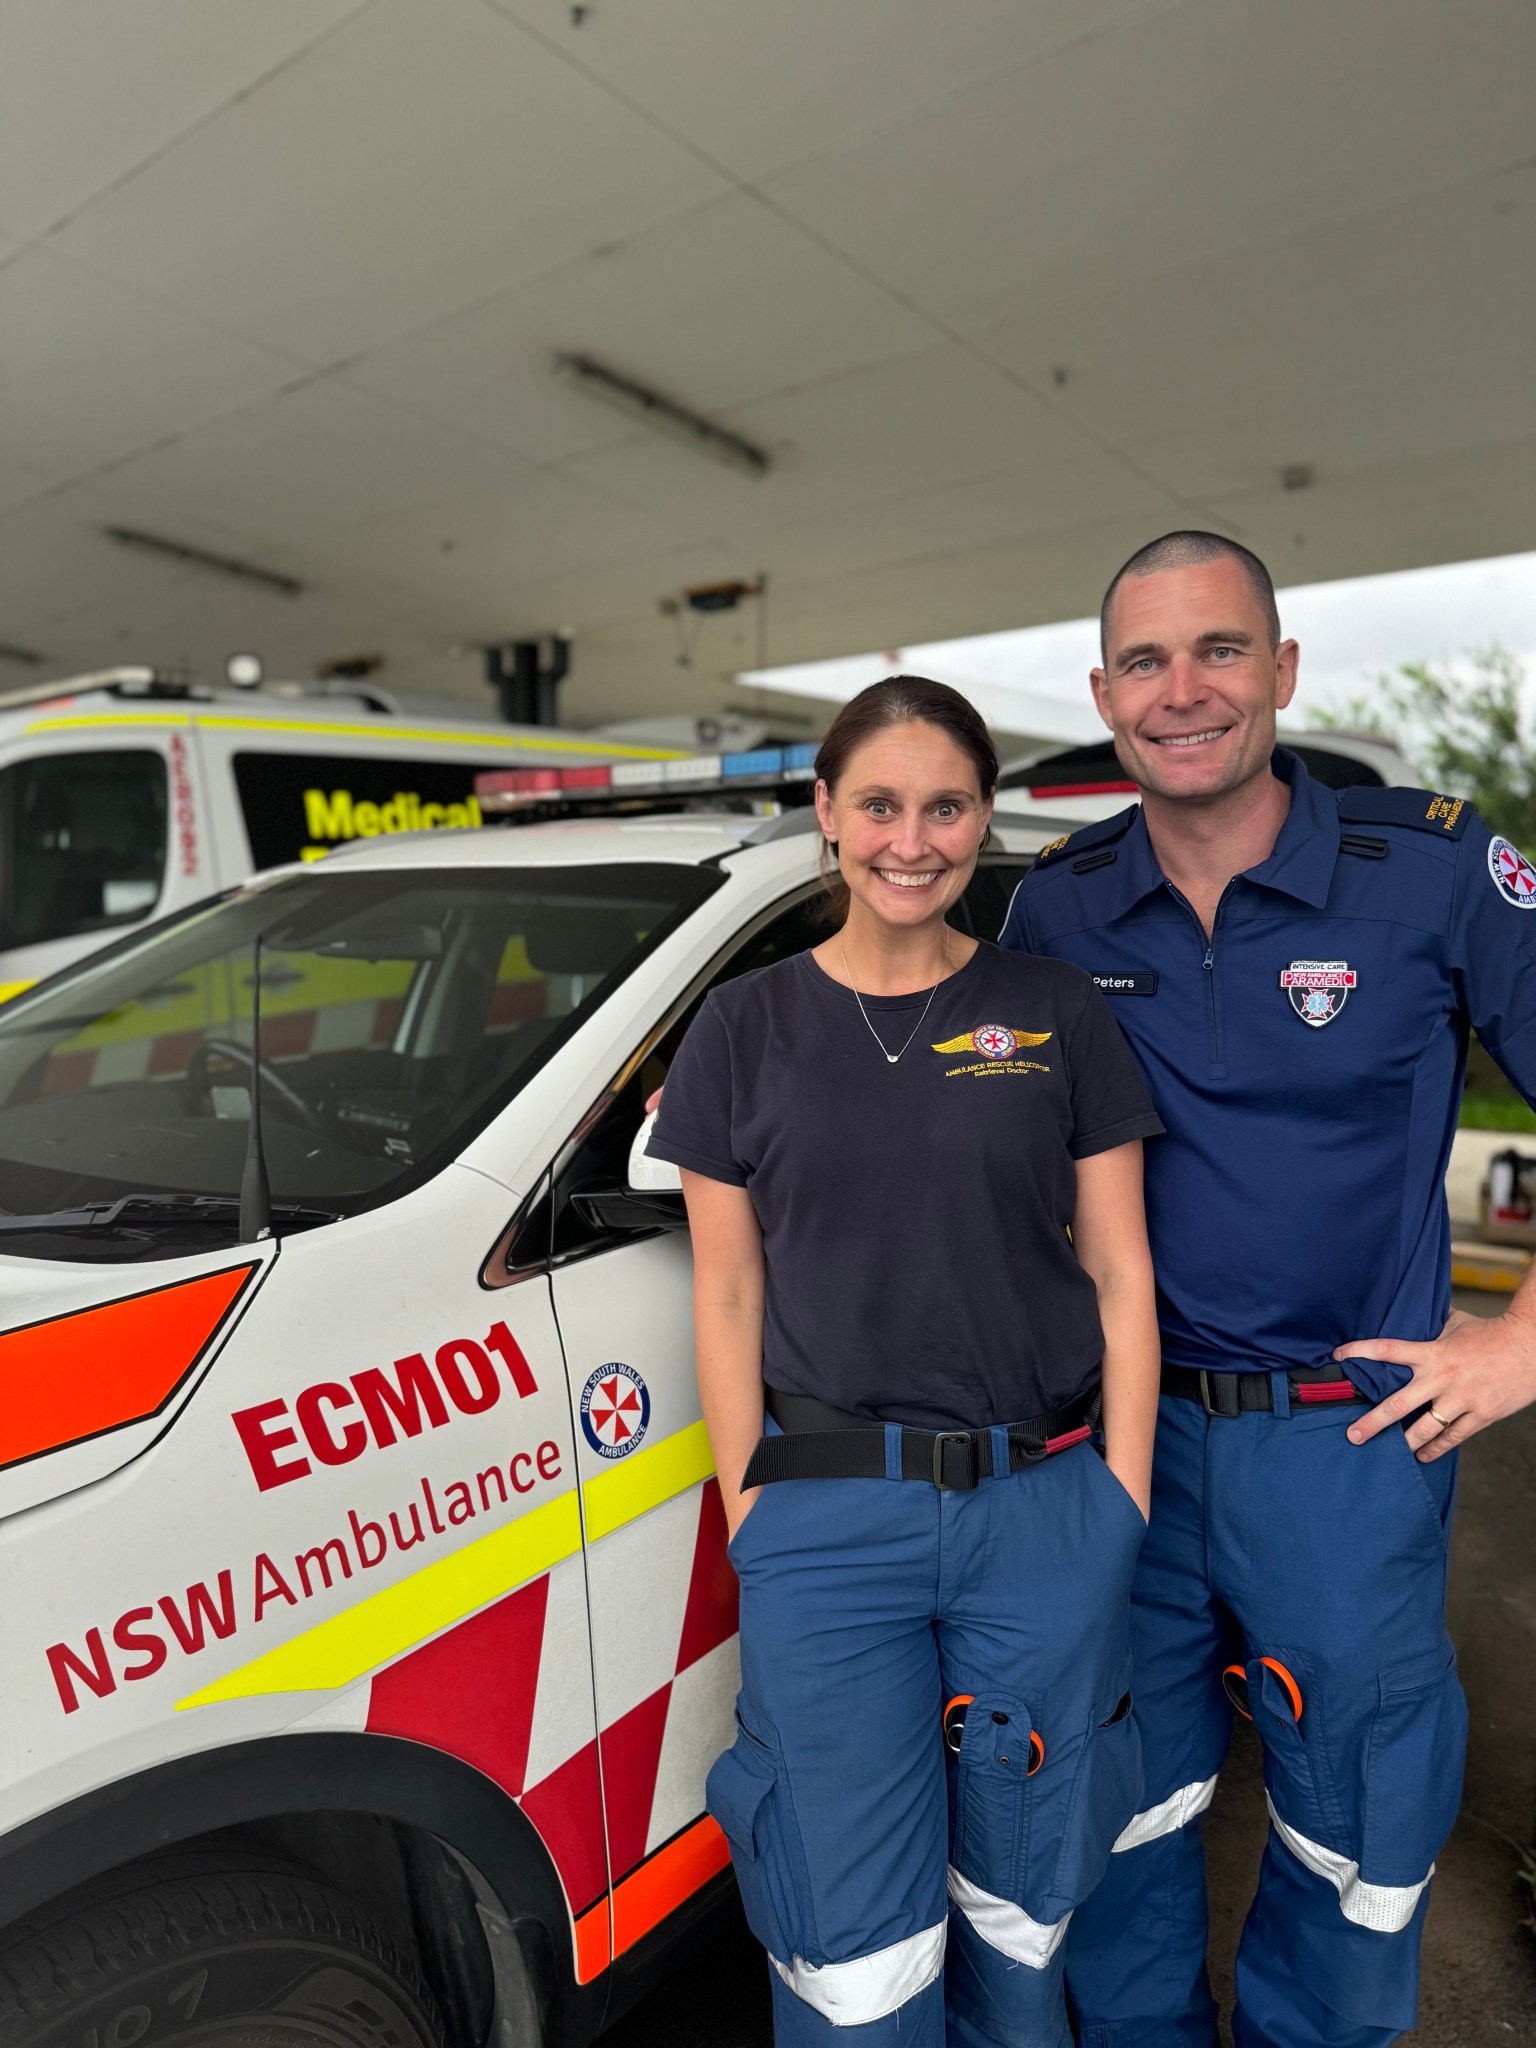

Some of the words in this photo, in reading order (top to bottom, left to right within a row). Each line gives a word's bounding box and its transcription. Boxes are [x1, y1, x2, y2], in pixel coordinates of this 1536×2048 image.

[1438, 802, 1452, 818] CARE
[1493, 863, 1506, 884] NEW
[945, 1063, 986, 1077] AMBULANCE
[986, 1061, 1014, 1069] RESCUE
[974, 1068, 1005, 1077] Retrieval
[1006, 1067, 1030, 1075] Doctor
[581, 1386, 592, 1413] NEW
[590, 1363, 617, 1387] SOUTH
[618, 1363, 645, 1390] WALES
[598, 1423, 647, 1458] AMBULANCE
[253, 1439, 563, 1623] Ambulance
